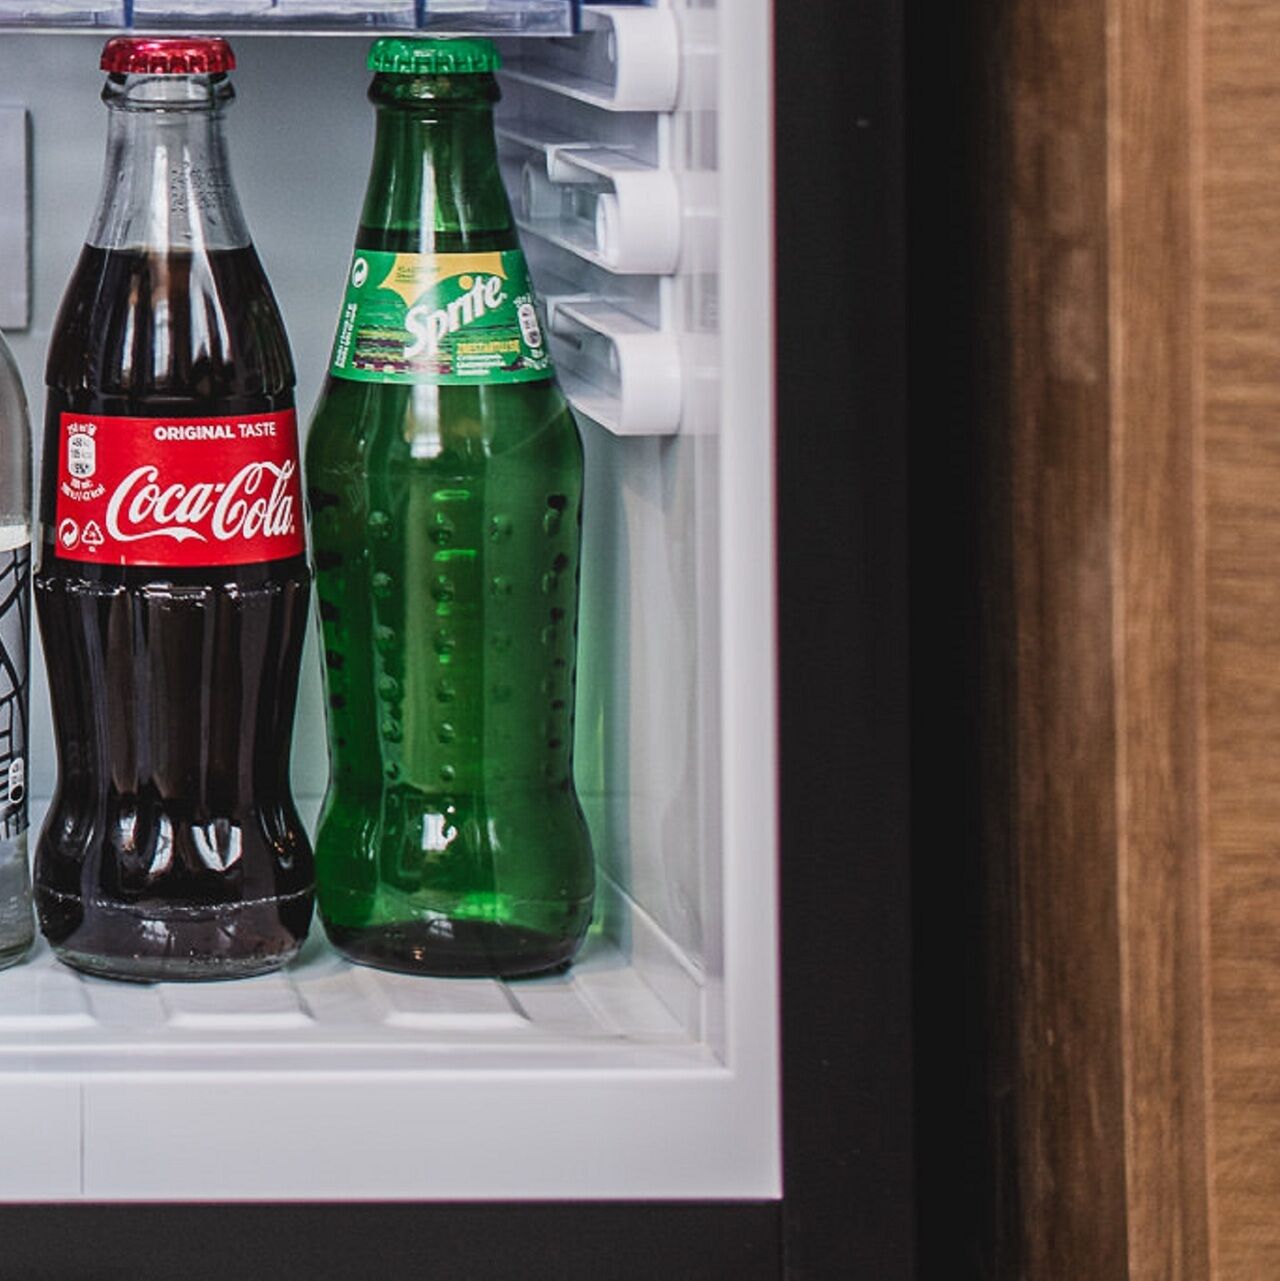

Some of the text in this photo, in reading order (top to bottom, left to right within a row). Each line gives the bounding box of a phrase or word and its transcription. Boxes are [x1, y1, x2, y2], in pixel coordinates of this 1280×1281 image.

[403, 275, 504, 359] Sprite
[153, 422, 276, 441] ORIGINAL TASTE
[105, 459, 296, 543] Coca-Cola
